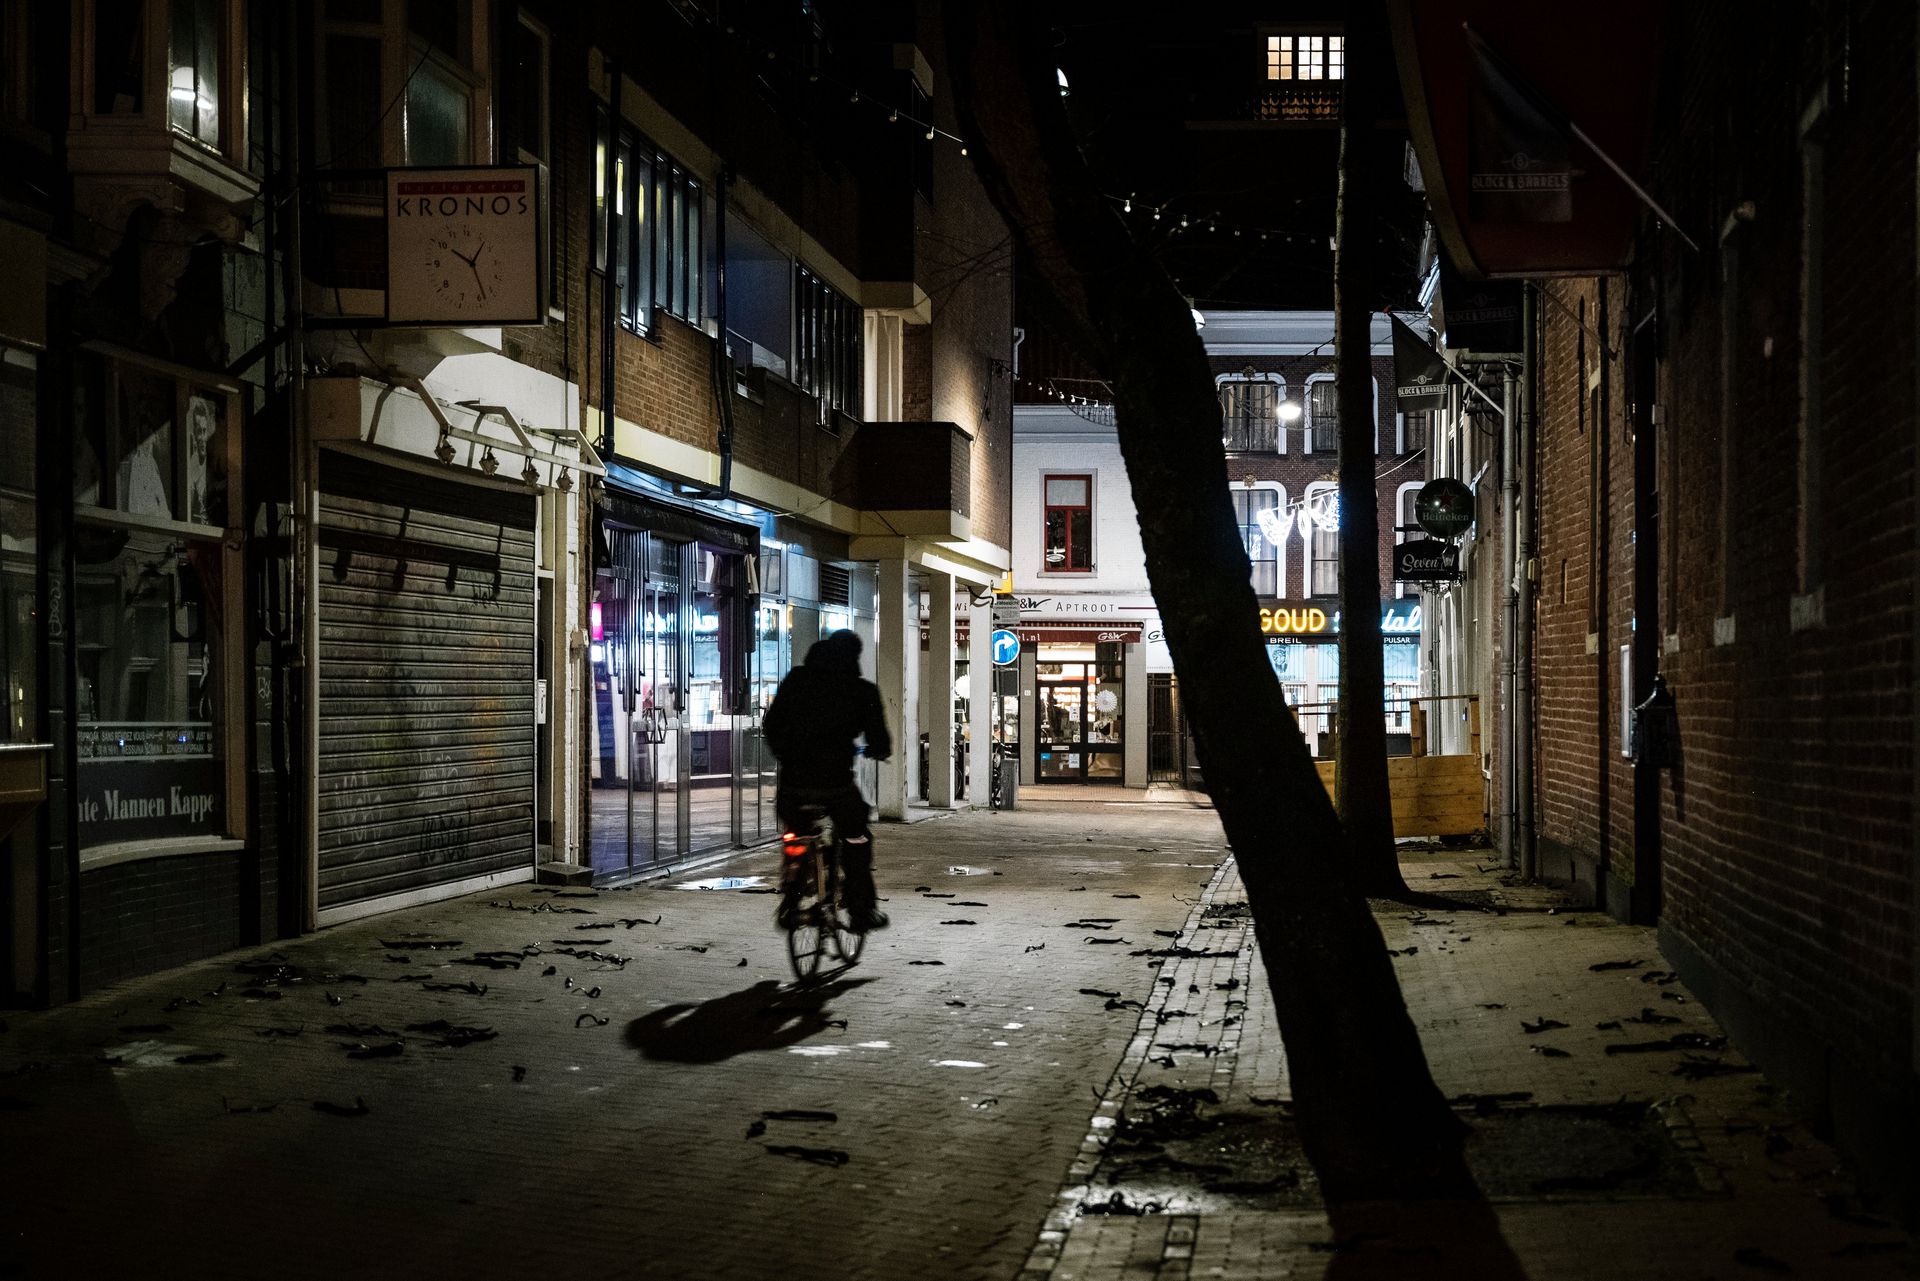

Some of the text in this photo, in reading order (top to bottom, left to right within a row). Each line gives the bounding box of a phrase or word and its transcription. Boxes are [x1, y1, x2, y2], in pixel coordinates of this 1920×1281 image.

[397, 195, 527, 217] KRONOS
[1422, 512, 1469, 521] Heineken
[1401, 553, 1439, 573] Seven
[1260, 608, 1327, 633] GOUD
[1097, 632, 1128, 642] G&W
[1384, 636, 1410, 644] PULSAR
[103, 789, 166, 821] Mannen
[170, 785, 215, 823] Kappe
